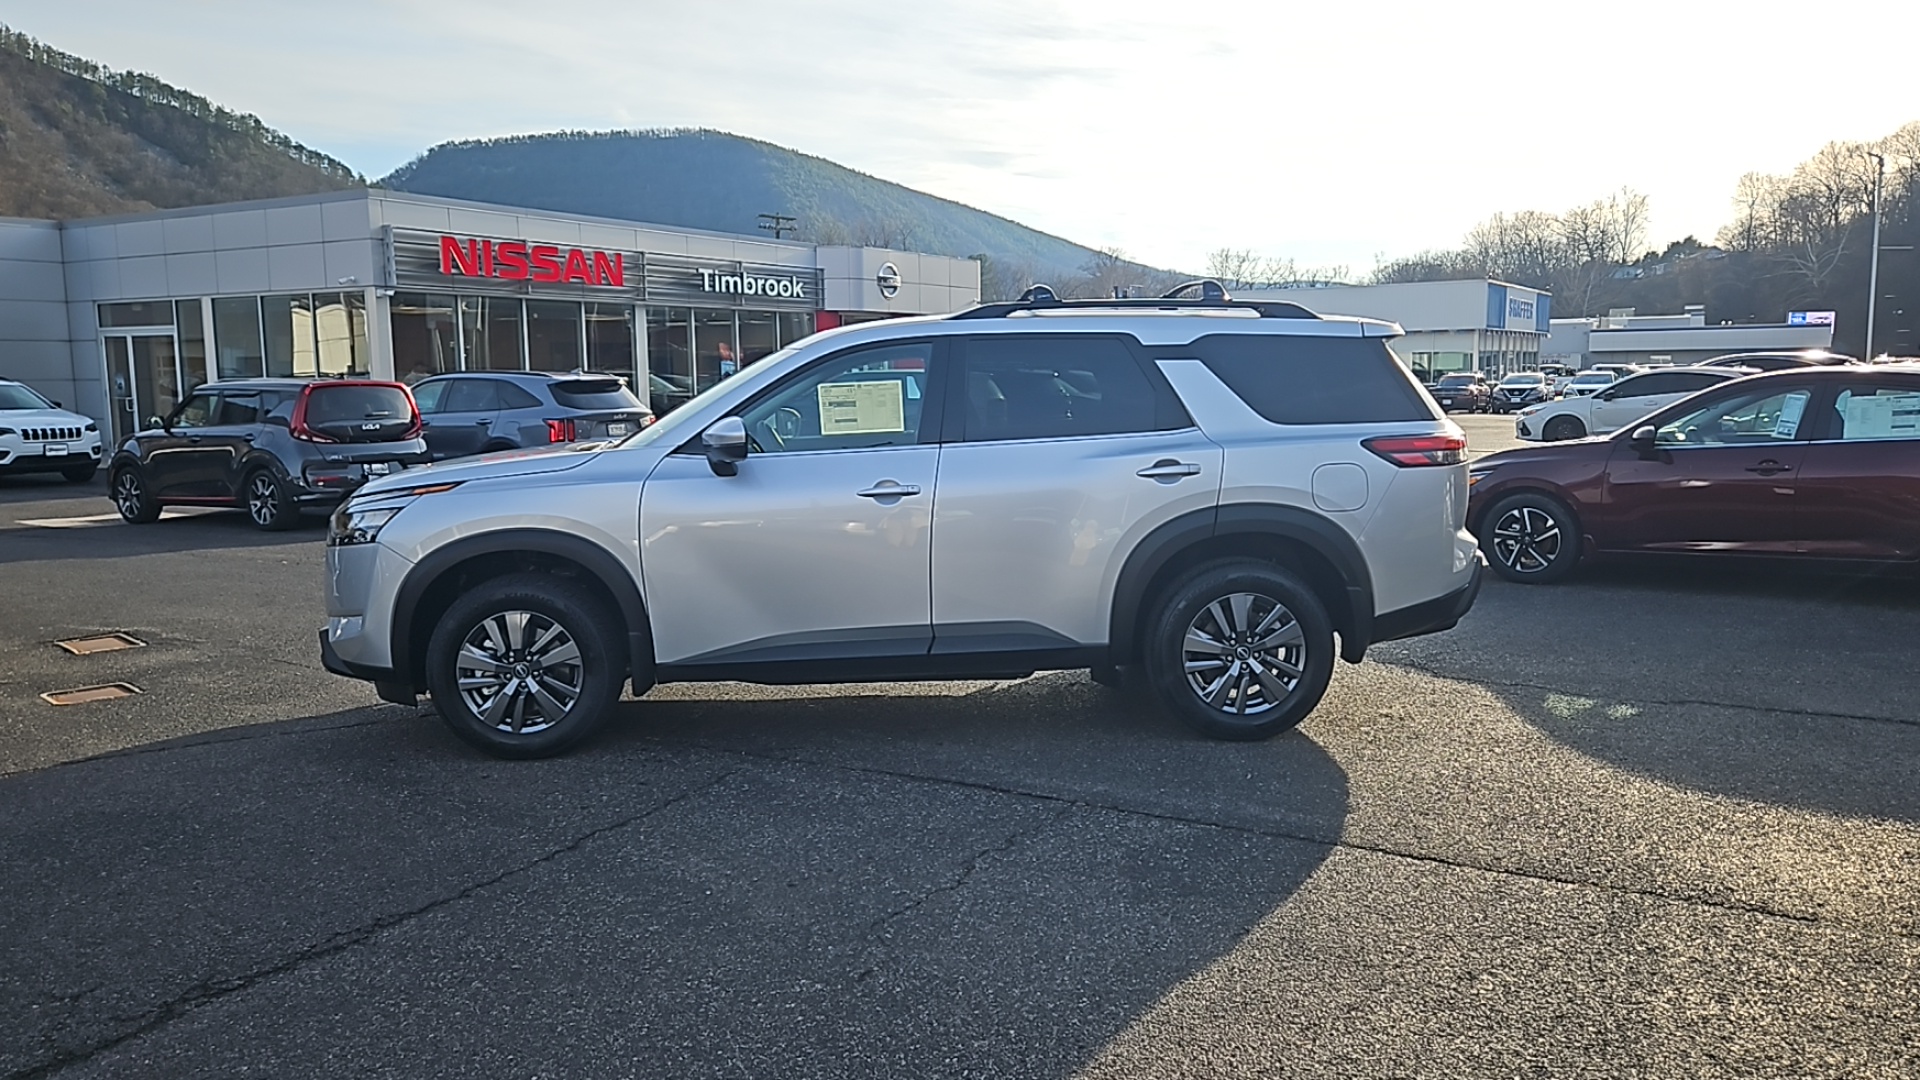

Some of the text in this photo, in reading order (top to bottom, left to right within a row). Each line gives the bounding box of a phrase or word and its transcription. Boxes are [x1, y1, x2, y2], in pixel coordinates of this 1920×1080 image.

[440, 236, 623, 286] NISSAN
[698, 268, 804, 297] Timbrook
[1509, 297, 1533, 319] SHAFFER
